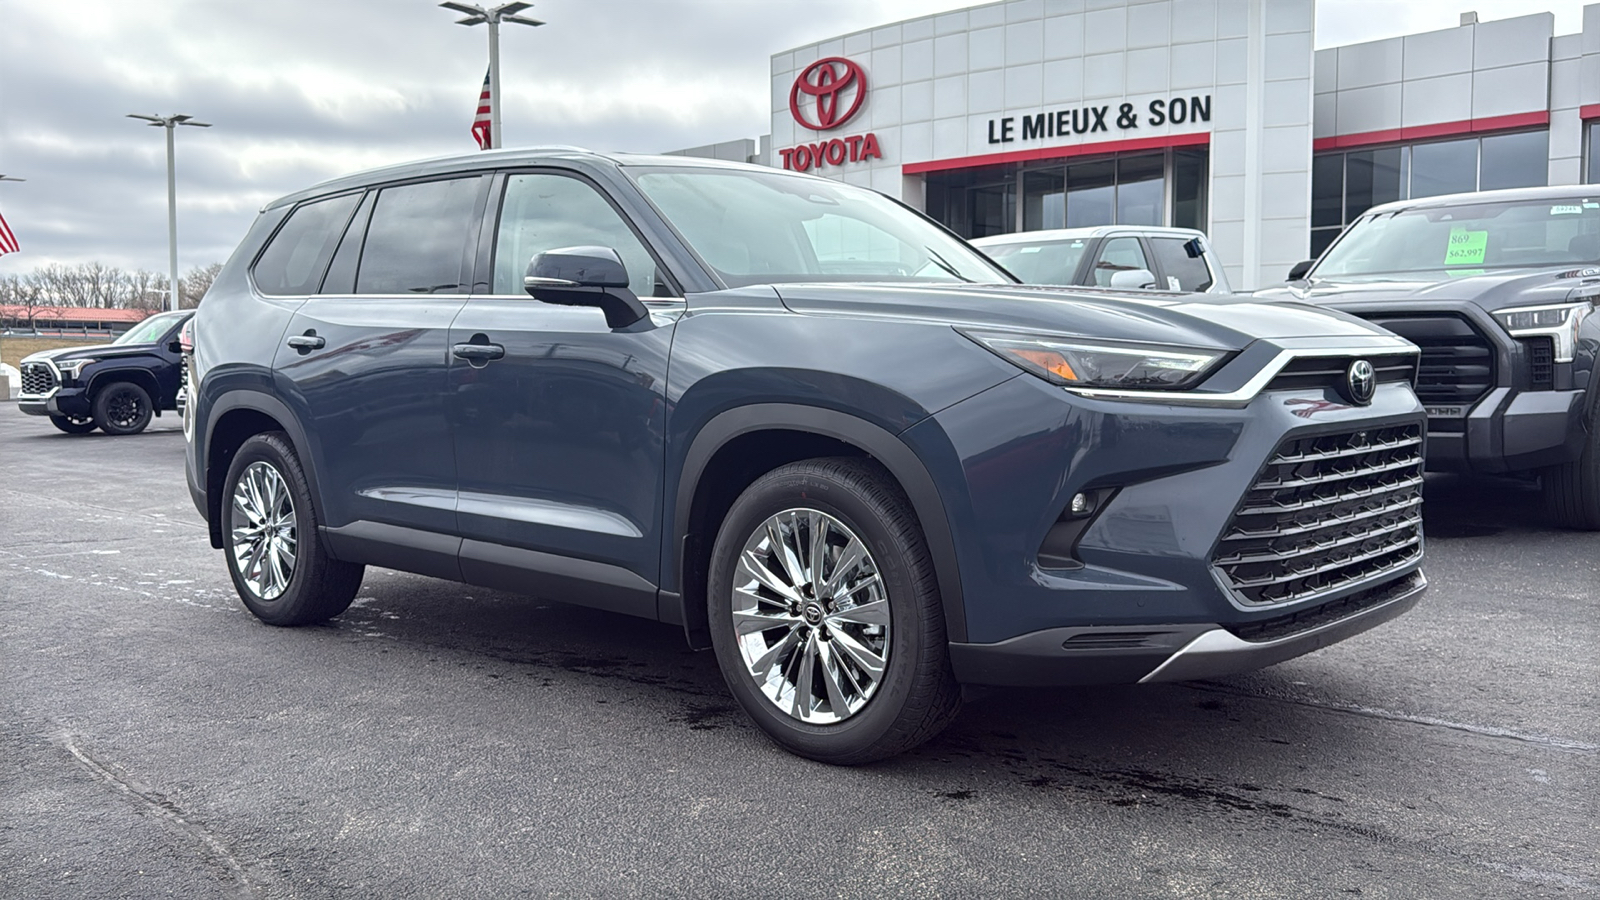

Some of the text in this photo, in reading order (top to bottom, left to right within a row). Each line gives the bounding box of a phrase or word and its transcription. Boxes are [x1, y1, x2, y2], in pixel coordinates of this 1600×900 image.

[988, 95, 1211, 144] LE MIEUX & SON
[779, 133, 882, 172] TOYOTA
[1451, 234, 1470, 244] 869
